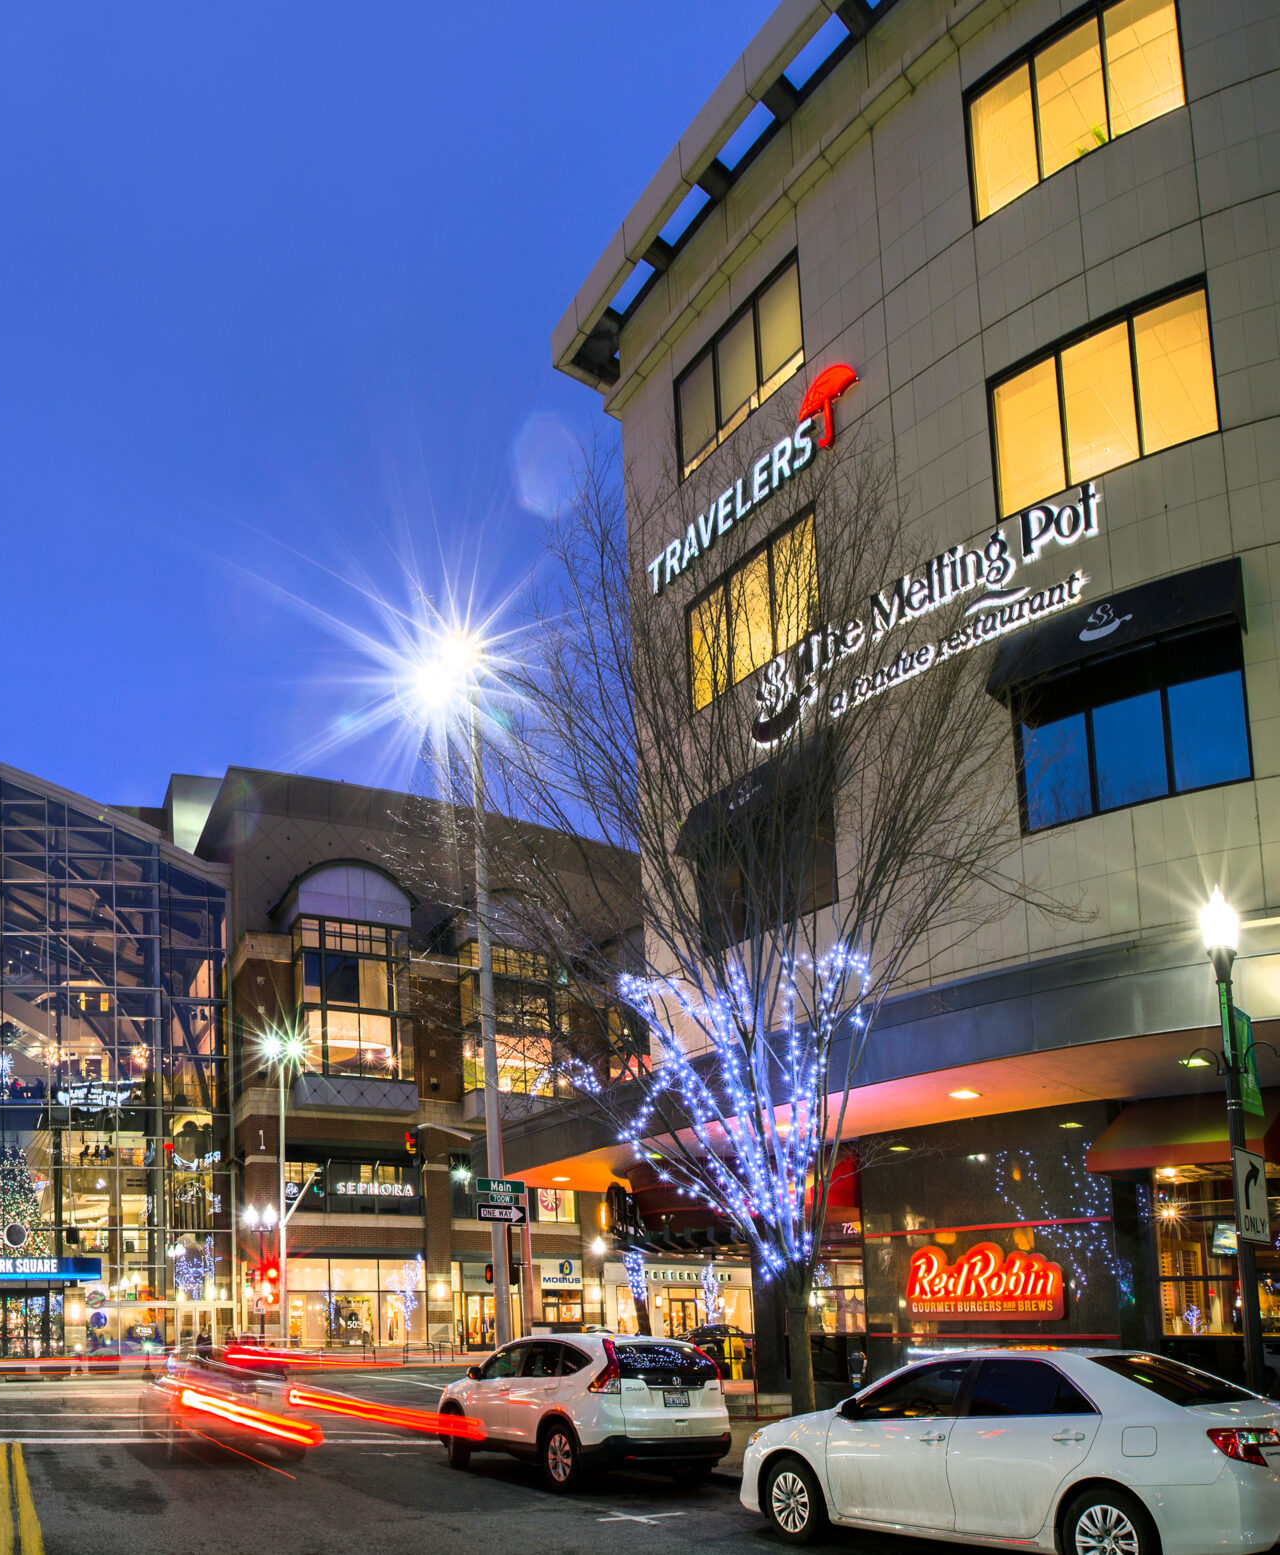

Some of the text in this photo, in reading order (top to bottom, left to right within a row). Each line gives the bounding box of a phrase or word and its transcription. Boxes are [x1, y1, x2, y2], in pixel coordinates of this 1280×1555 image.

[648, 418, 812, 595] TRAVELERS
[799, 482, 1097, 675] The Melting Pot
[830, 571, 1083, 716] a fondue restaurant
[336, 1182, 414, 1197] SEPHORA
[490, 1180, 512, 1192] Main
[483, 1209, 513, 1218] ONE WAY
[1244, 1214, 1266, 1234] ONLY
[16, 1259, 58, 1273] SQUARE
[644, 1270, 699, 1280] POTTERY
[911, 1250, 1054, 1299] Red Robin
[912, 1300, 1054, 1313] GOURMET BURGERS AND BREWS
